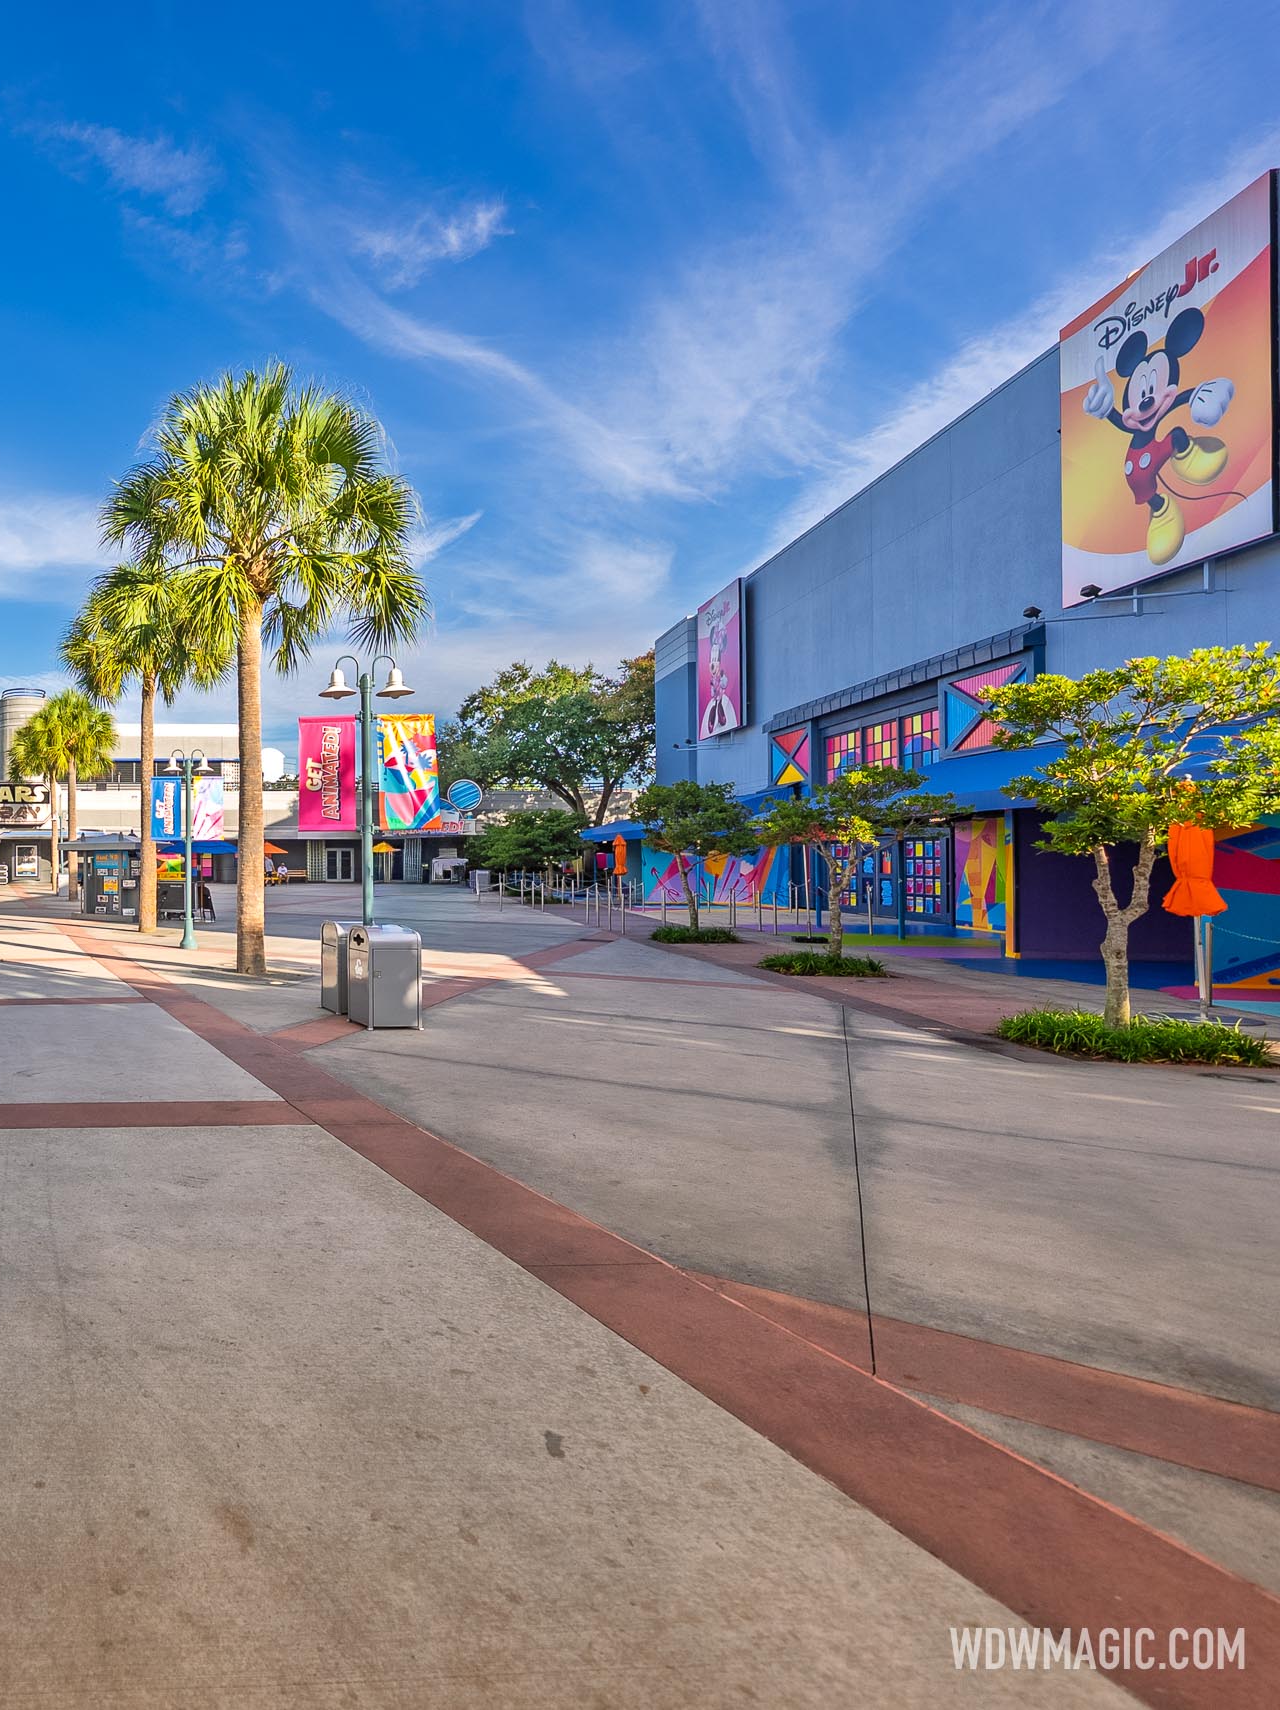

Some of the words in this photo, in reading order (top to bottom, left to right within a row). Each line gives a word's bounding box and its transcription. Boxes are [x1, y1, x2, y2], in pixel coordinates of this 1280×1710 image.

[1177, 247, 1220, 298] Jr.
[305, 757, 323, 792] GET
[321, 726, 341, 820] ANIMATED!
[0, 805, 41, 820] BAY
